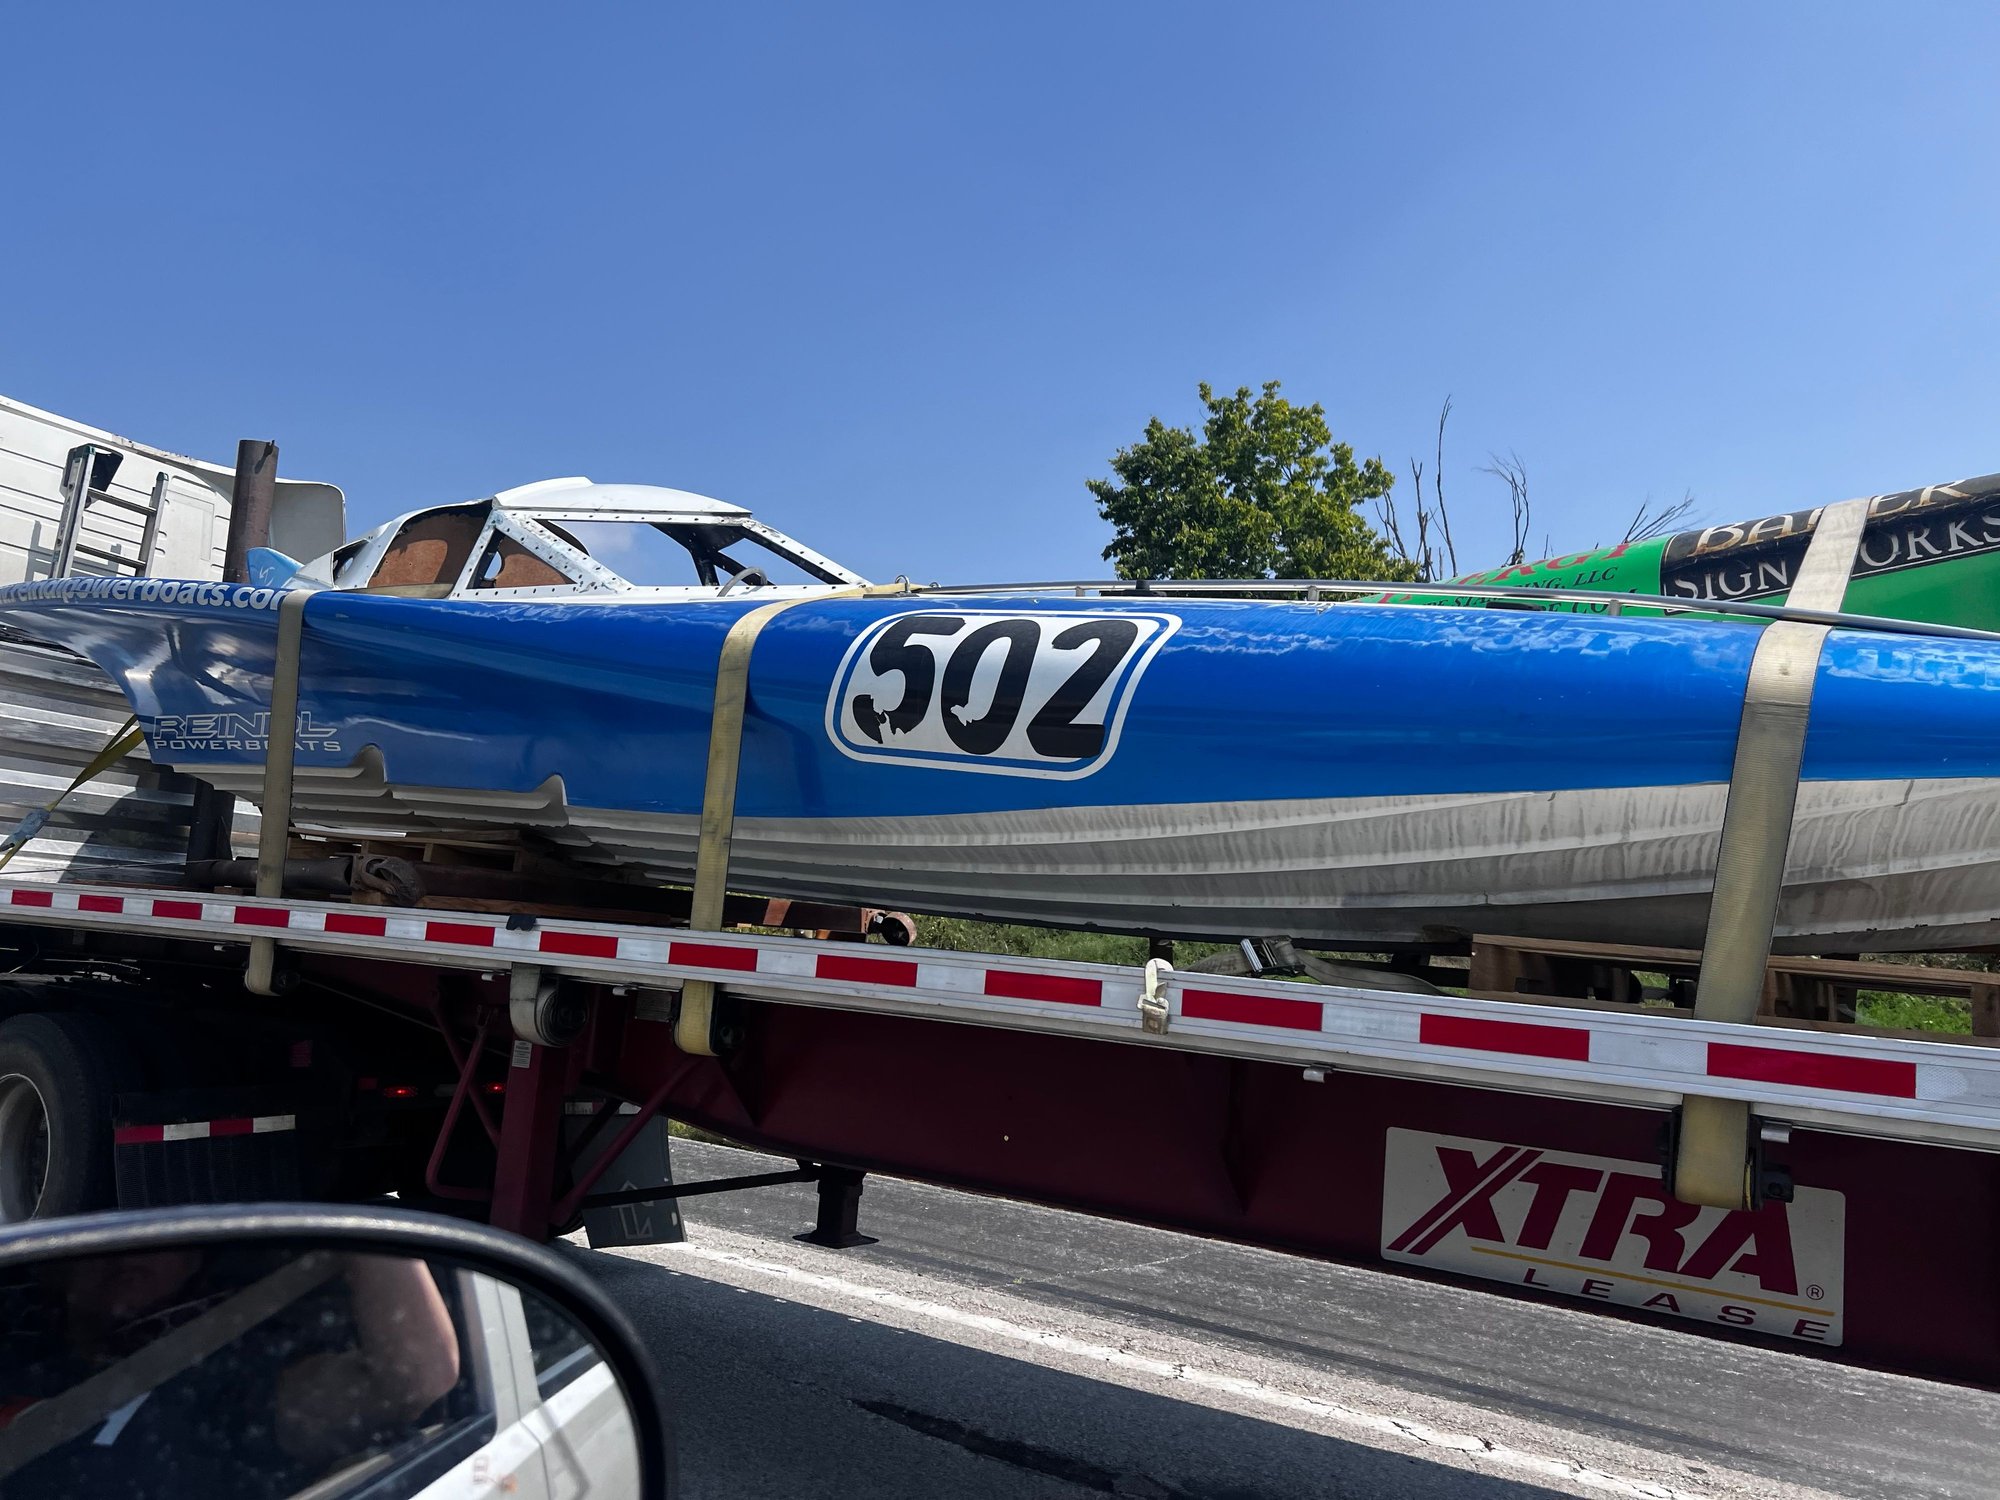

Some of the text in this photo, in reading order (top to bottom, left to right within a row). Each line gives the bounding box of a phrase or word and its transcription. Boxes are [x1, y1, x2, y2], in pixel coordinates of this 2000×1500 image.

[1686, 479, 1971, 558] BAER
[1573, 566, 1618, 587] LLC
[1674, 514, 2000, 600] SIGN ORKS
[153, 711, 338, 740] REINL
[852, 617, 1139, 758] 502
[154, 740, 341, 751] POWERBTS
[1387, 1146, 1799, 1297] XTRA
[1522, 1267, 1831, 1341] LEASE
